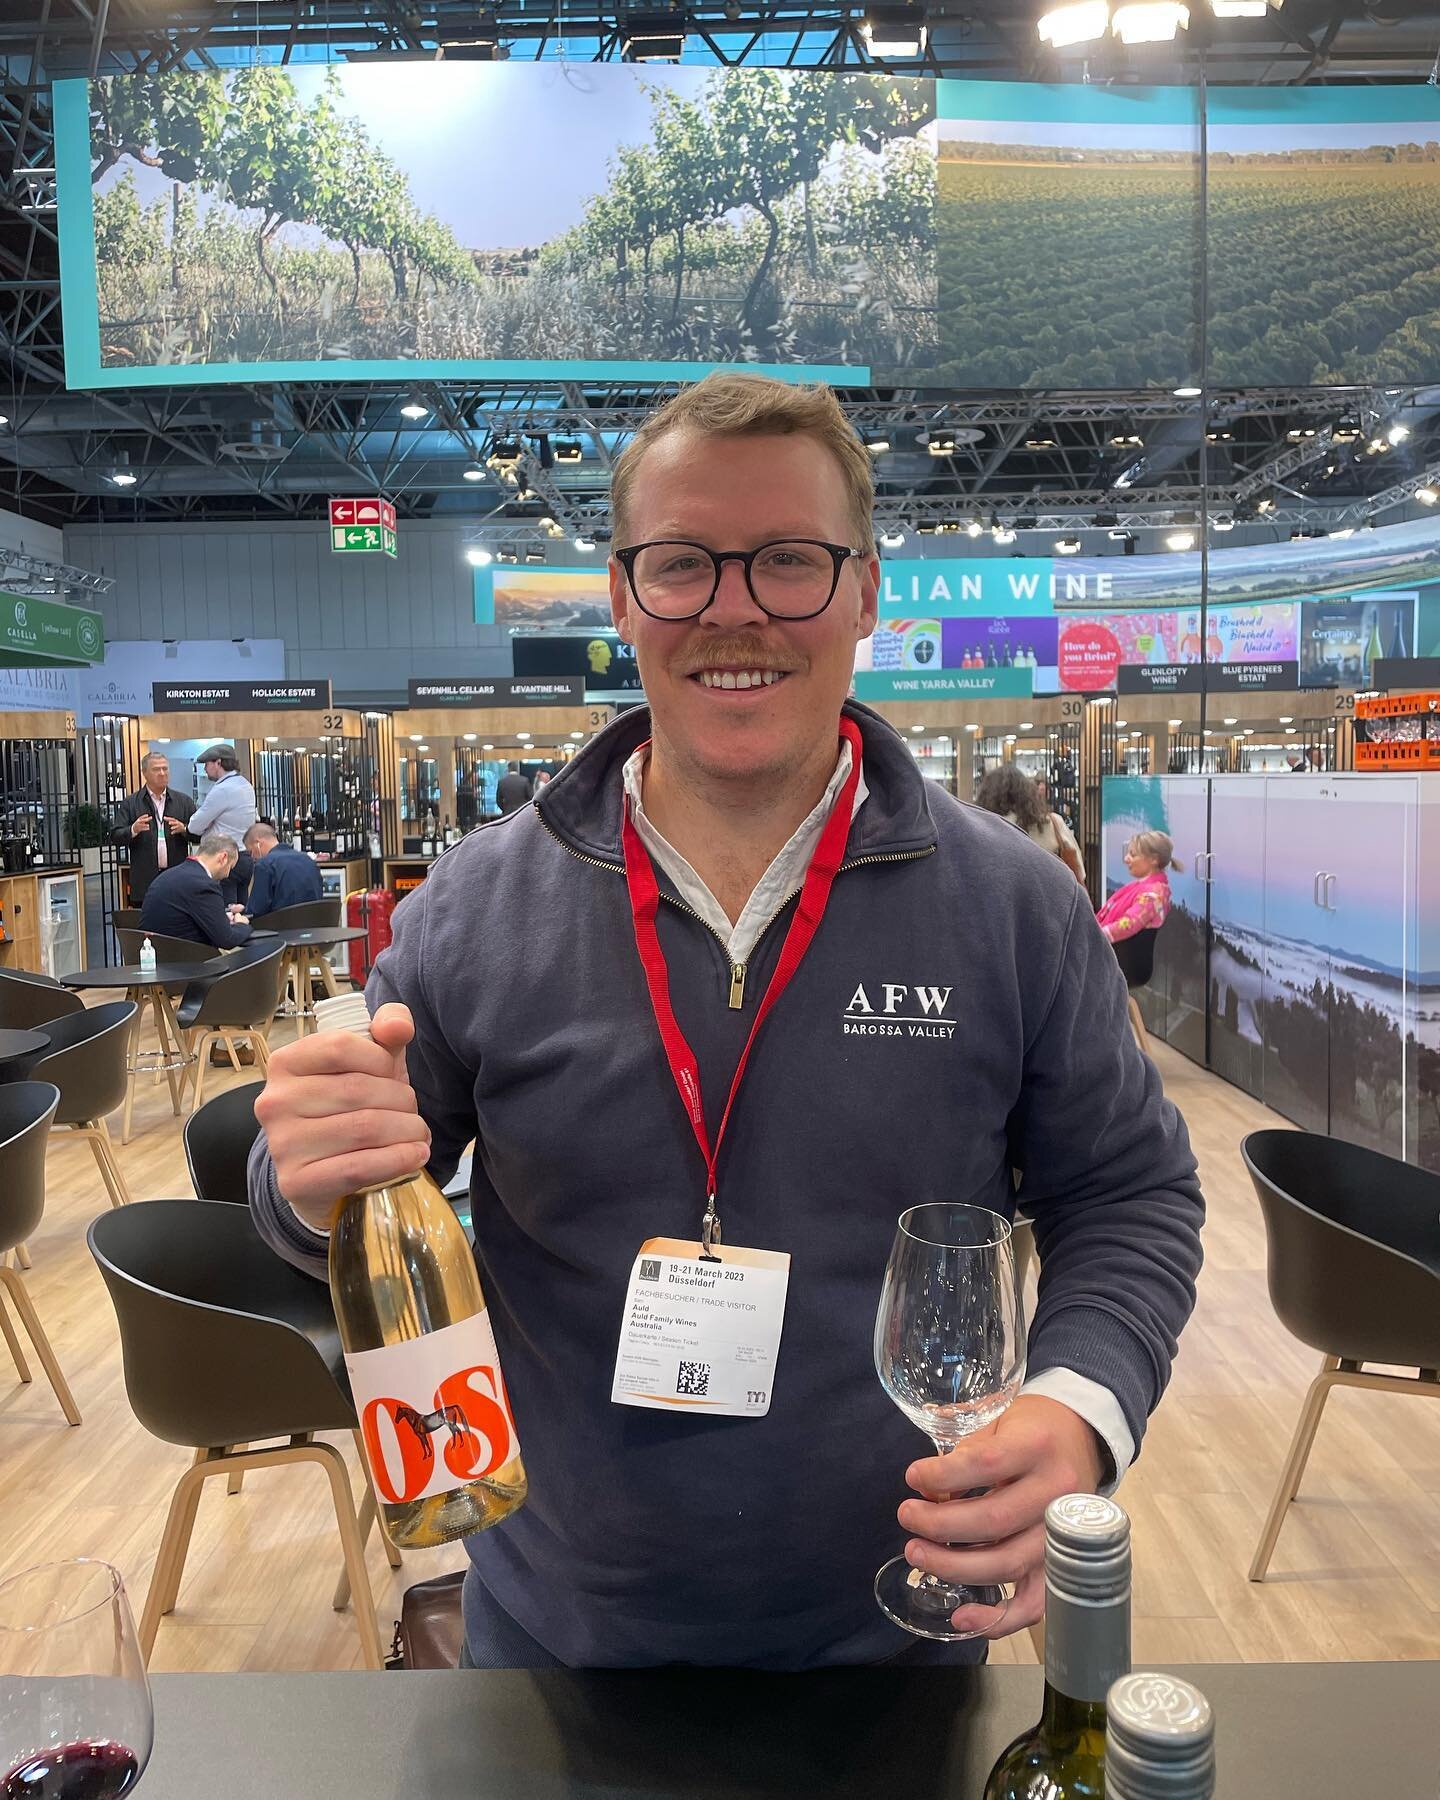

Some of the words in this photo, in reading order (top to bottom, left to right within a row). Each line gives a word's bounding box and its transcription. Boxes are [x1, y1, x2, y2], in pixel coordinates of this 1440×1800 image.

[1008, 572, 1114, 600] WINE
[7, 627, 37, 641] CASELLA
[1064, 642, 1085, 651] How
[1088, 641, 1101, 650] do
[1063, 654, 1082, 664] you
[1141, 667, 1188, 677] GLENLOFTY
[1222, 666, 1241, 675] BLUE
[1243, 665, 1282, 674] PYRENEES
[0, 667, 67, 691] ALABRIA
[892, 681, 919, 690] WINE
[921, 680, 956, 689] YARRA
[957, 678, 995, 689] VALLEY
[1152, 676, 1177, 684] WINES
[1238, 674, 1267, 682] ESTATE
[166, 690, 201, 698] KIRKTON
[202, 689, 230, 698] ESTATE
[252, 689, 287, 697] HOLLICK
[288, 688, 316, 697] ESTATE
[416, 686, 458, 695] SEVENHILL
[459, 685, 495, 694] CELLARS
[510, 685, 552, 694] LEVANTINE
[553, 685, 571, 693] HILL
[1335, 695, 1355, 709] 29
[1062, 703, 1082, 716] 30
[66, 717, 76, 731] 33
[323, 716, 343, 729] 32
[591, 712, 608, 725] 31
[843, 1023, 903, 1036] BAROSSA
[908, 1025, 955, 1039] VALLEY
[669, 1264, 691, 1275] 19-21
[694, 1267, 722, 1279] March
[724, 1271, 744, 1281] 2023
[668, 1274, 715, 1288] Düsseldorf
[634, 1289, 695, 1303] FACHBESUCHER
[701, 1298, 726, 1308] TRADE
[727, 1301, 757, 1312] VISITOR
[632, 1304, 649, 1312] Auld
[630, 1320, 662, 1331] Australia
[631, 1312, 648, 1321] Auld
[649, 1315, 673, 1325] Family
[675, 1318, 697, 1327] Wines
